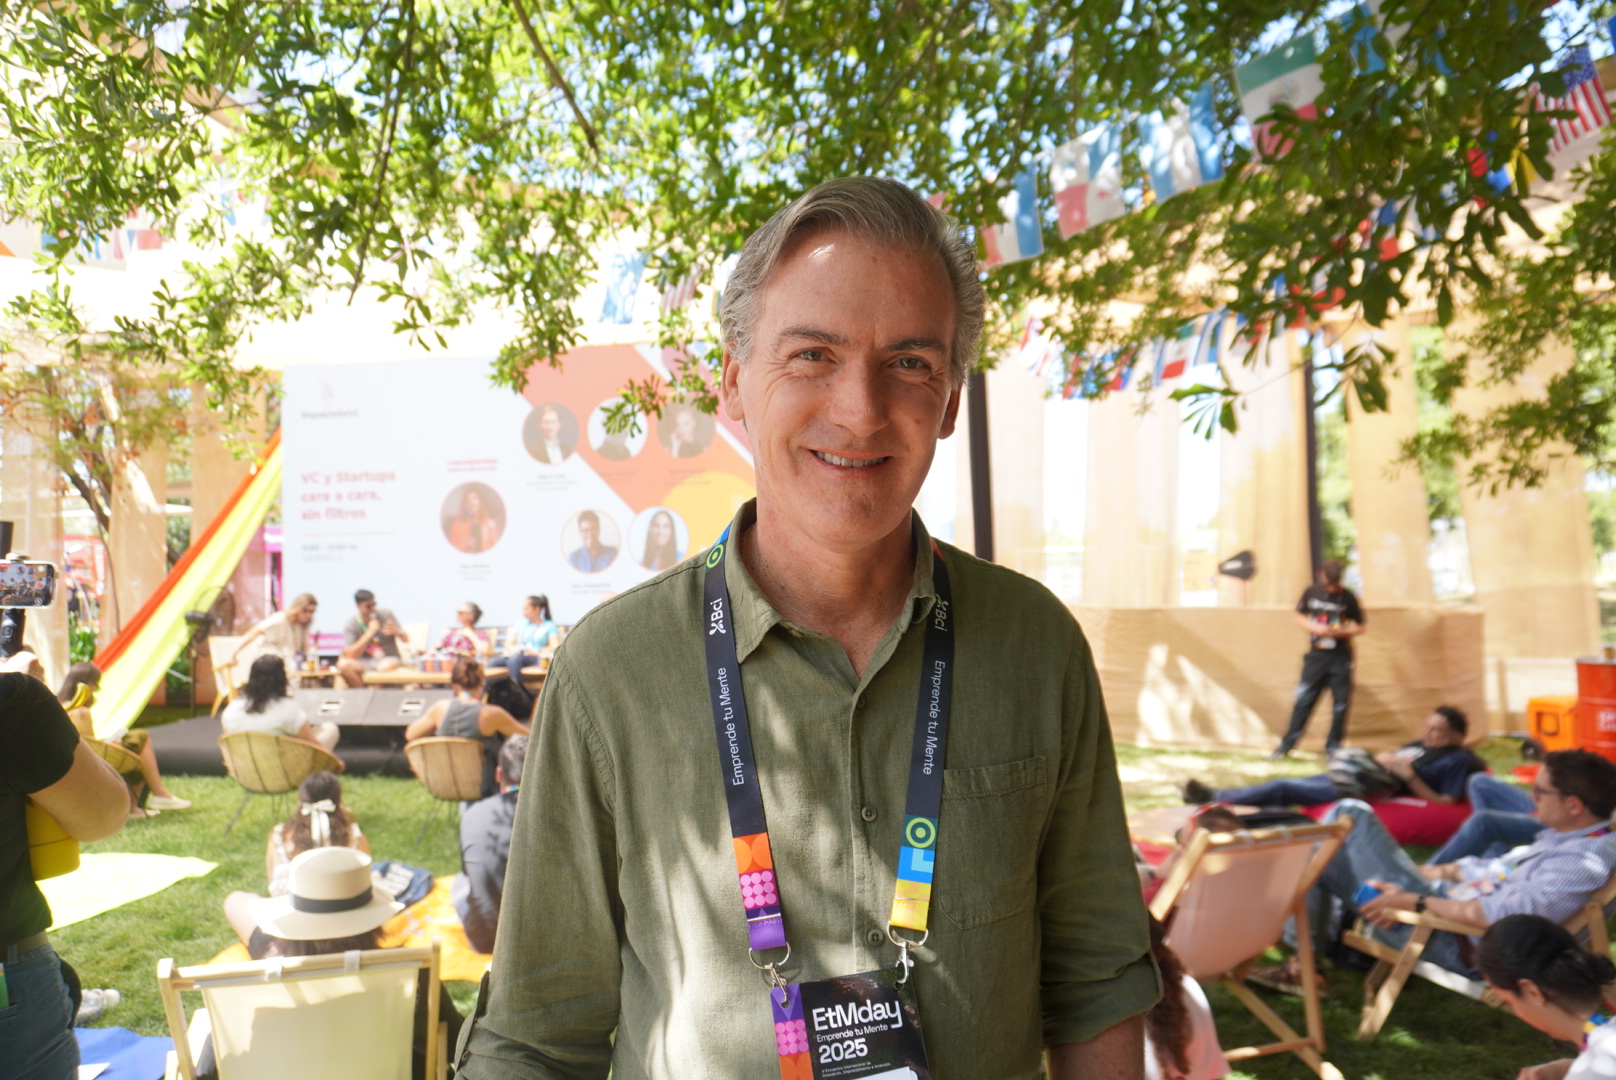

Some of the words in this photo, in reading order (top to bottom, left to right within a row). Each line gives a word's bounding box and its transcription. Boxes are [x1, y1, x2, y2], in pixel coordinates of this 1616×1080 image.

[301, 472, 319, 484] VC
[324, 474, 331, 486] y
[336, 471, 396, 484] Startups
[301, 492, 330, 503] cara
[335, 492, 343, 501] a
[301, 508, 321, 520] sin
[325, 507, 366, 519] filtros
[717, 667, 731, 706] Mente
[929, 660, 945, 719] Emprende
[723, 707, 734, 722] tu
[927, 720, 939, 734] tu
[725, 722, 745, 786] Emprende
[922, 735, 939, 775] Mente
[812, 999, 903, 1031] EtMday
[816, 1029, 853, 1042] Emprende
[854, 1027, 864, 1036] tu
[864, 1023, 888, 1034] Mente
[818, 1037, 868, 1064] 2025
